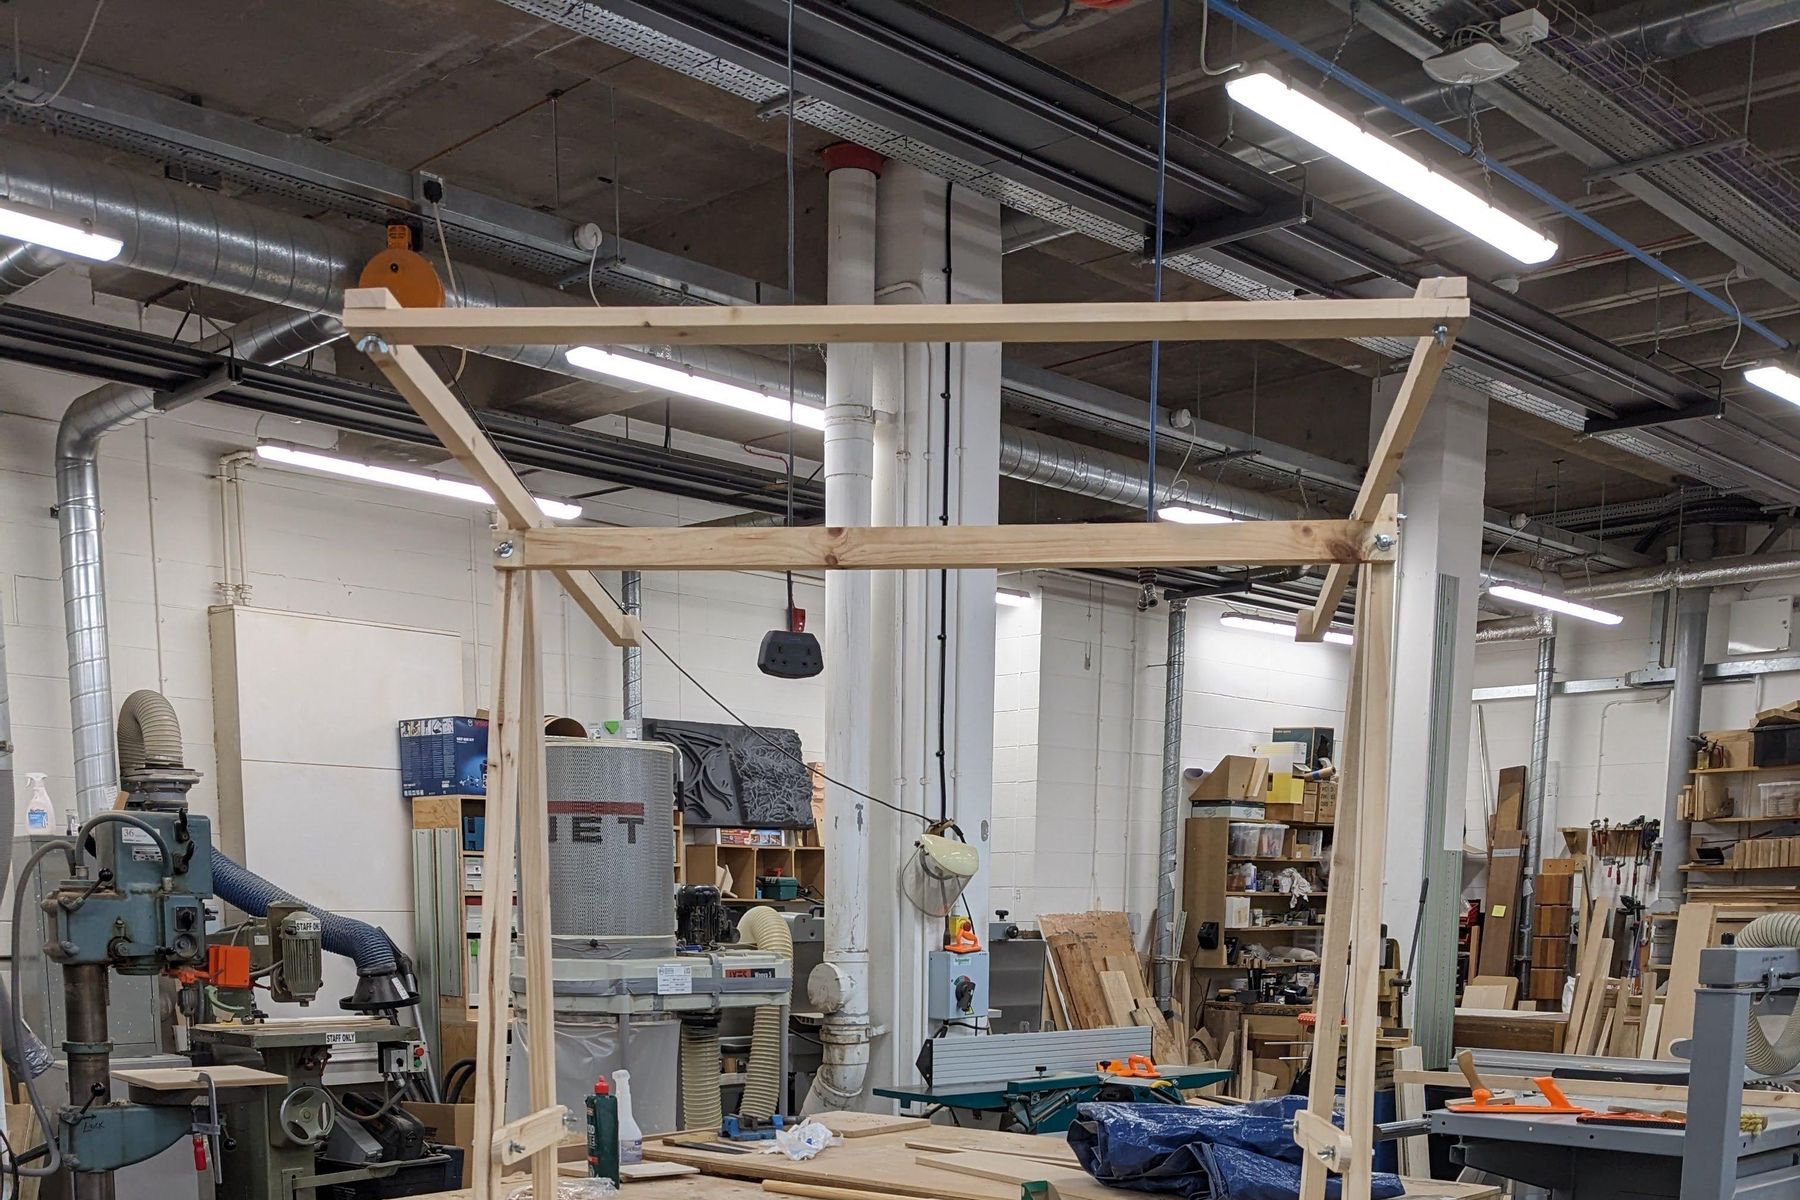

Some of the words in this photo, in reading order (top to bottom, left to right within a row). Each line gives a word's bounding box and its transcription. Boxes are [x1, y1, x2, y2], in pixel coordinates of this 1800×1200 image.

[296, 922, 312, 931] STAFF
[327, 1034, 341, 1043] STAFF
[342, 1033, 355, 1042] ONLY
